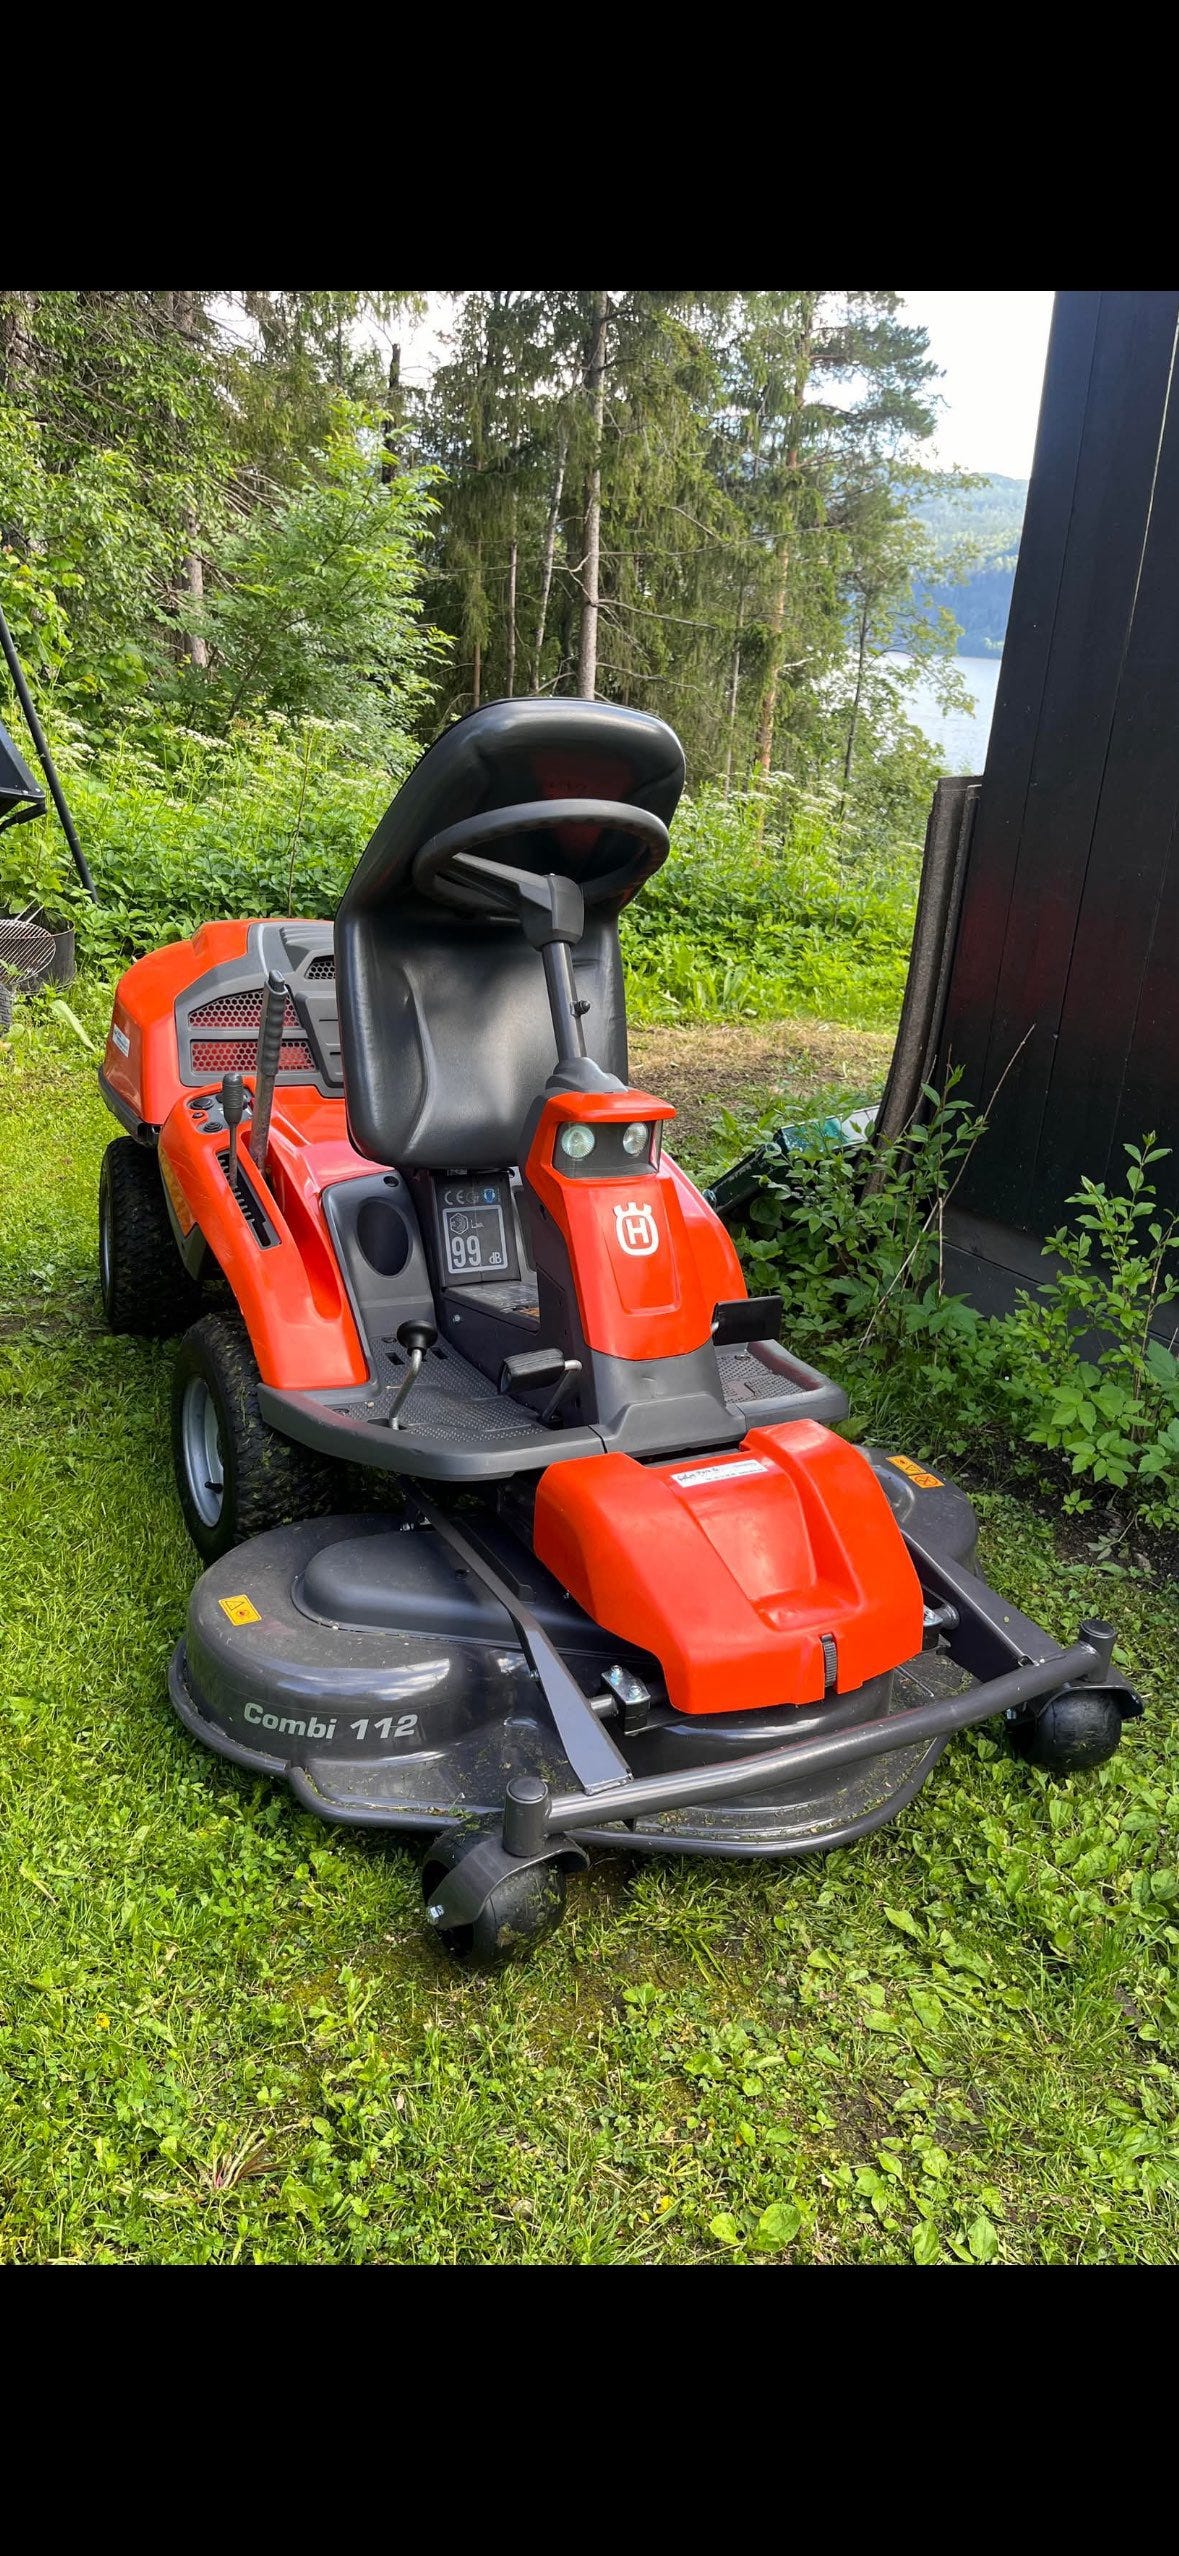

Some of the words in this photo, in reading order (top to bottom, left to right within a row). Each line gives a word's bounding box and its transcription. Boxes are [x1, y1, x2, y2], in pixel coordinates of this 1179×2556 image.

[444, 1190, 465, 1205] CE
[451, 1235, 481, 1268] 99
[489, 1251, 502, 1264] dB
[244, 1702, 338, 1740] Combi
[350, 1714, 418, 1740] 112
